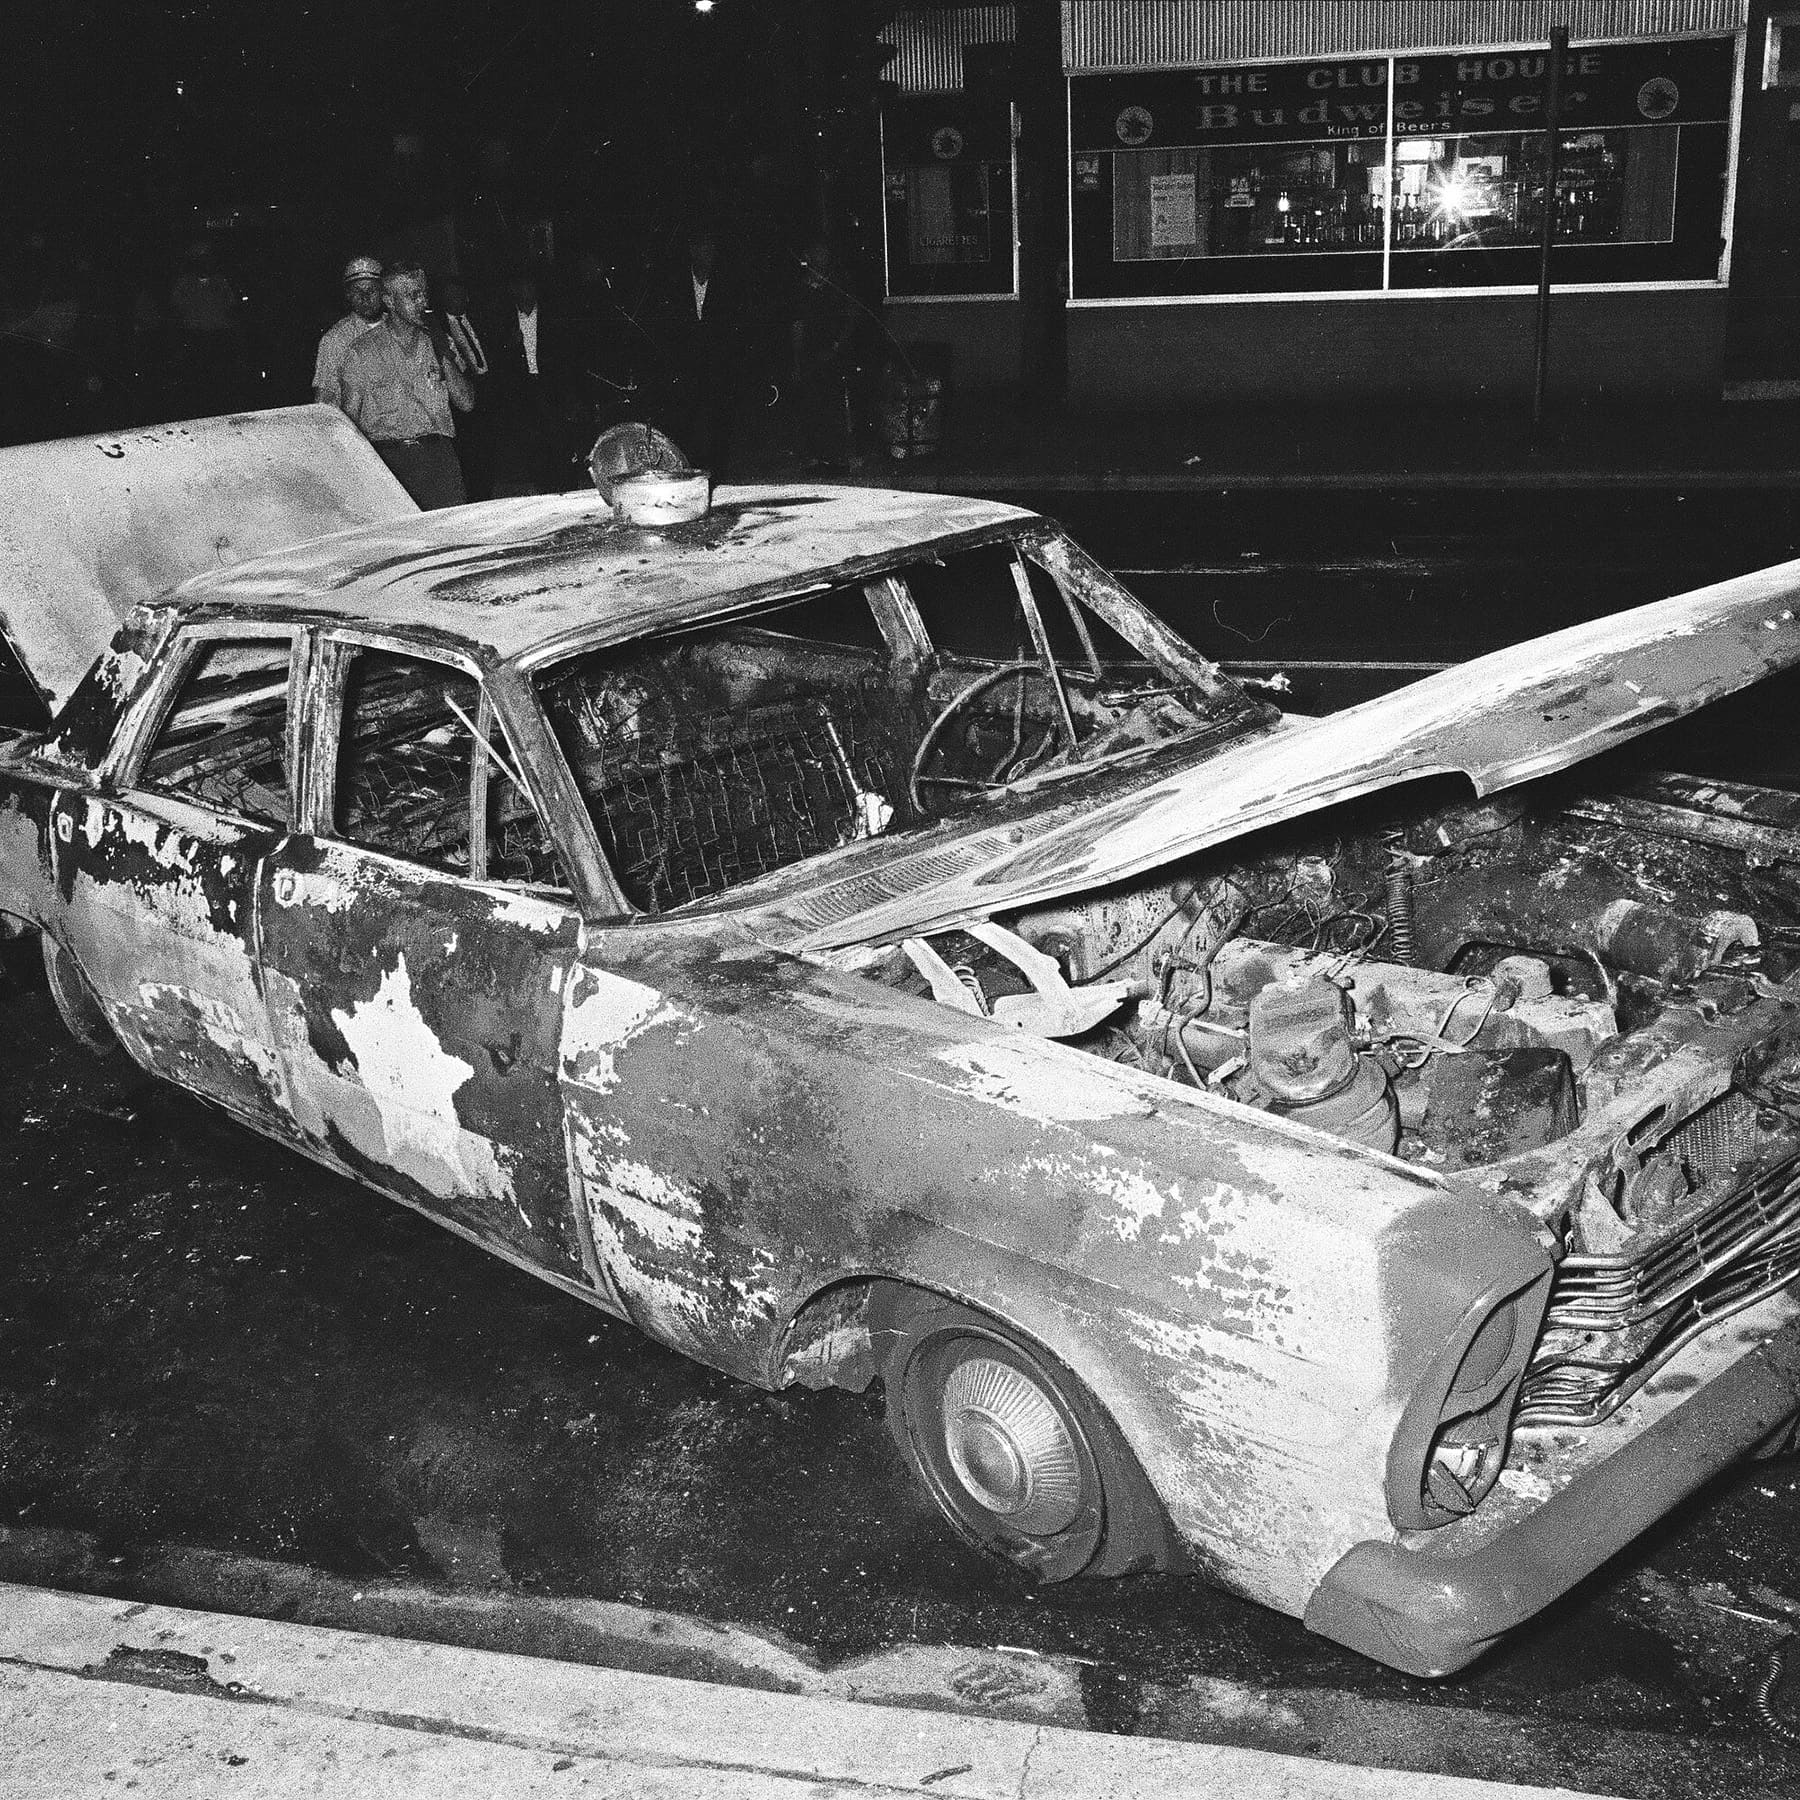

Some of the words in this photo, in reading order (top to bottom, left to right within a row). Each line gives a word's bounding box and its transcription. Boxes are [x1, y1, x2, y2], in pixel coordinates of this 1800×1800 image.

[1196, 73, 1268, 95] THE
[1306, 64, 1421, 90] CLUB
[1196, 91, 1588, 130] Budweiser
[1327, 124, 1360, 138] King
[1368, 124, 1386, 136] of
[1396, 121, 1451, 132] Beers
